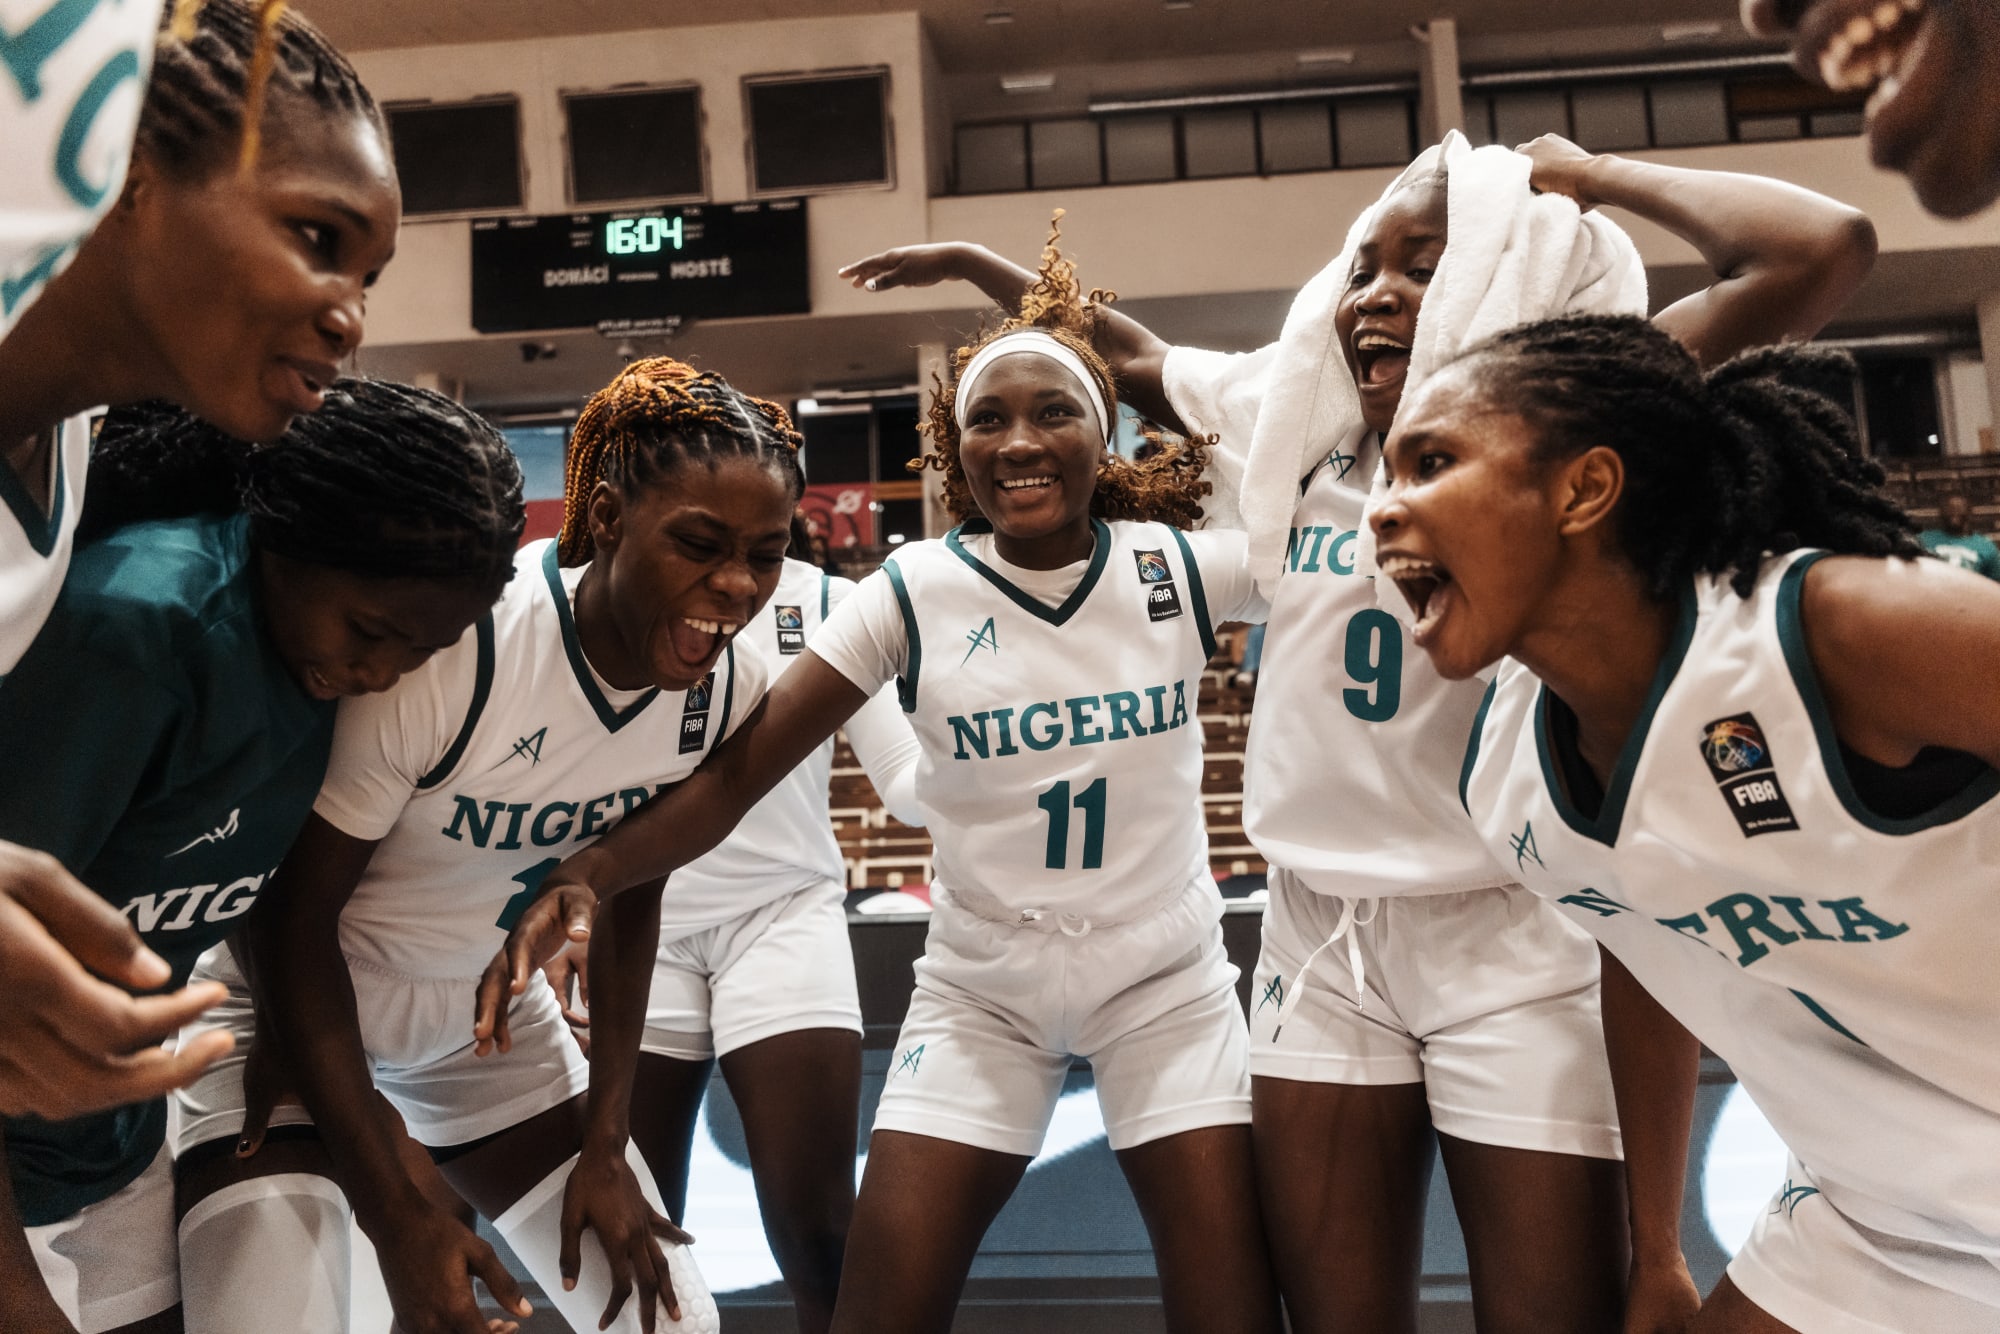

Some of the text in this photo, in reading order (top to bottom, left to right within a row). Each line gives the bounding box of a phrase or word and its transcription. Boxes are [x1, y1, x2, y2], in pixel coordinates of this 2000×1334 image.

[606, 217, 682, 254] 16:04
[1282, 526, 1360, 576] NIG
[1150, 588, 1172, 603] FIBA
[1343, 608, 1403, 722] 9
[684, 718, 704, 733] FIBA
[947, 679, 1189, 760] NIGERIA
[442, 783, 668, 850] NIGER
[1732, 780, 1778, 807] FIBA
[1038, 777, 1107, 870] 11
[119, 867, 278, 933] NIG
